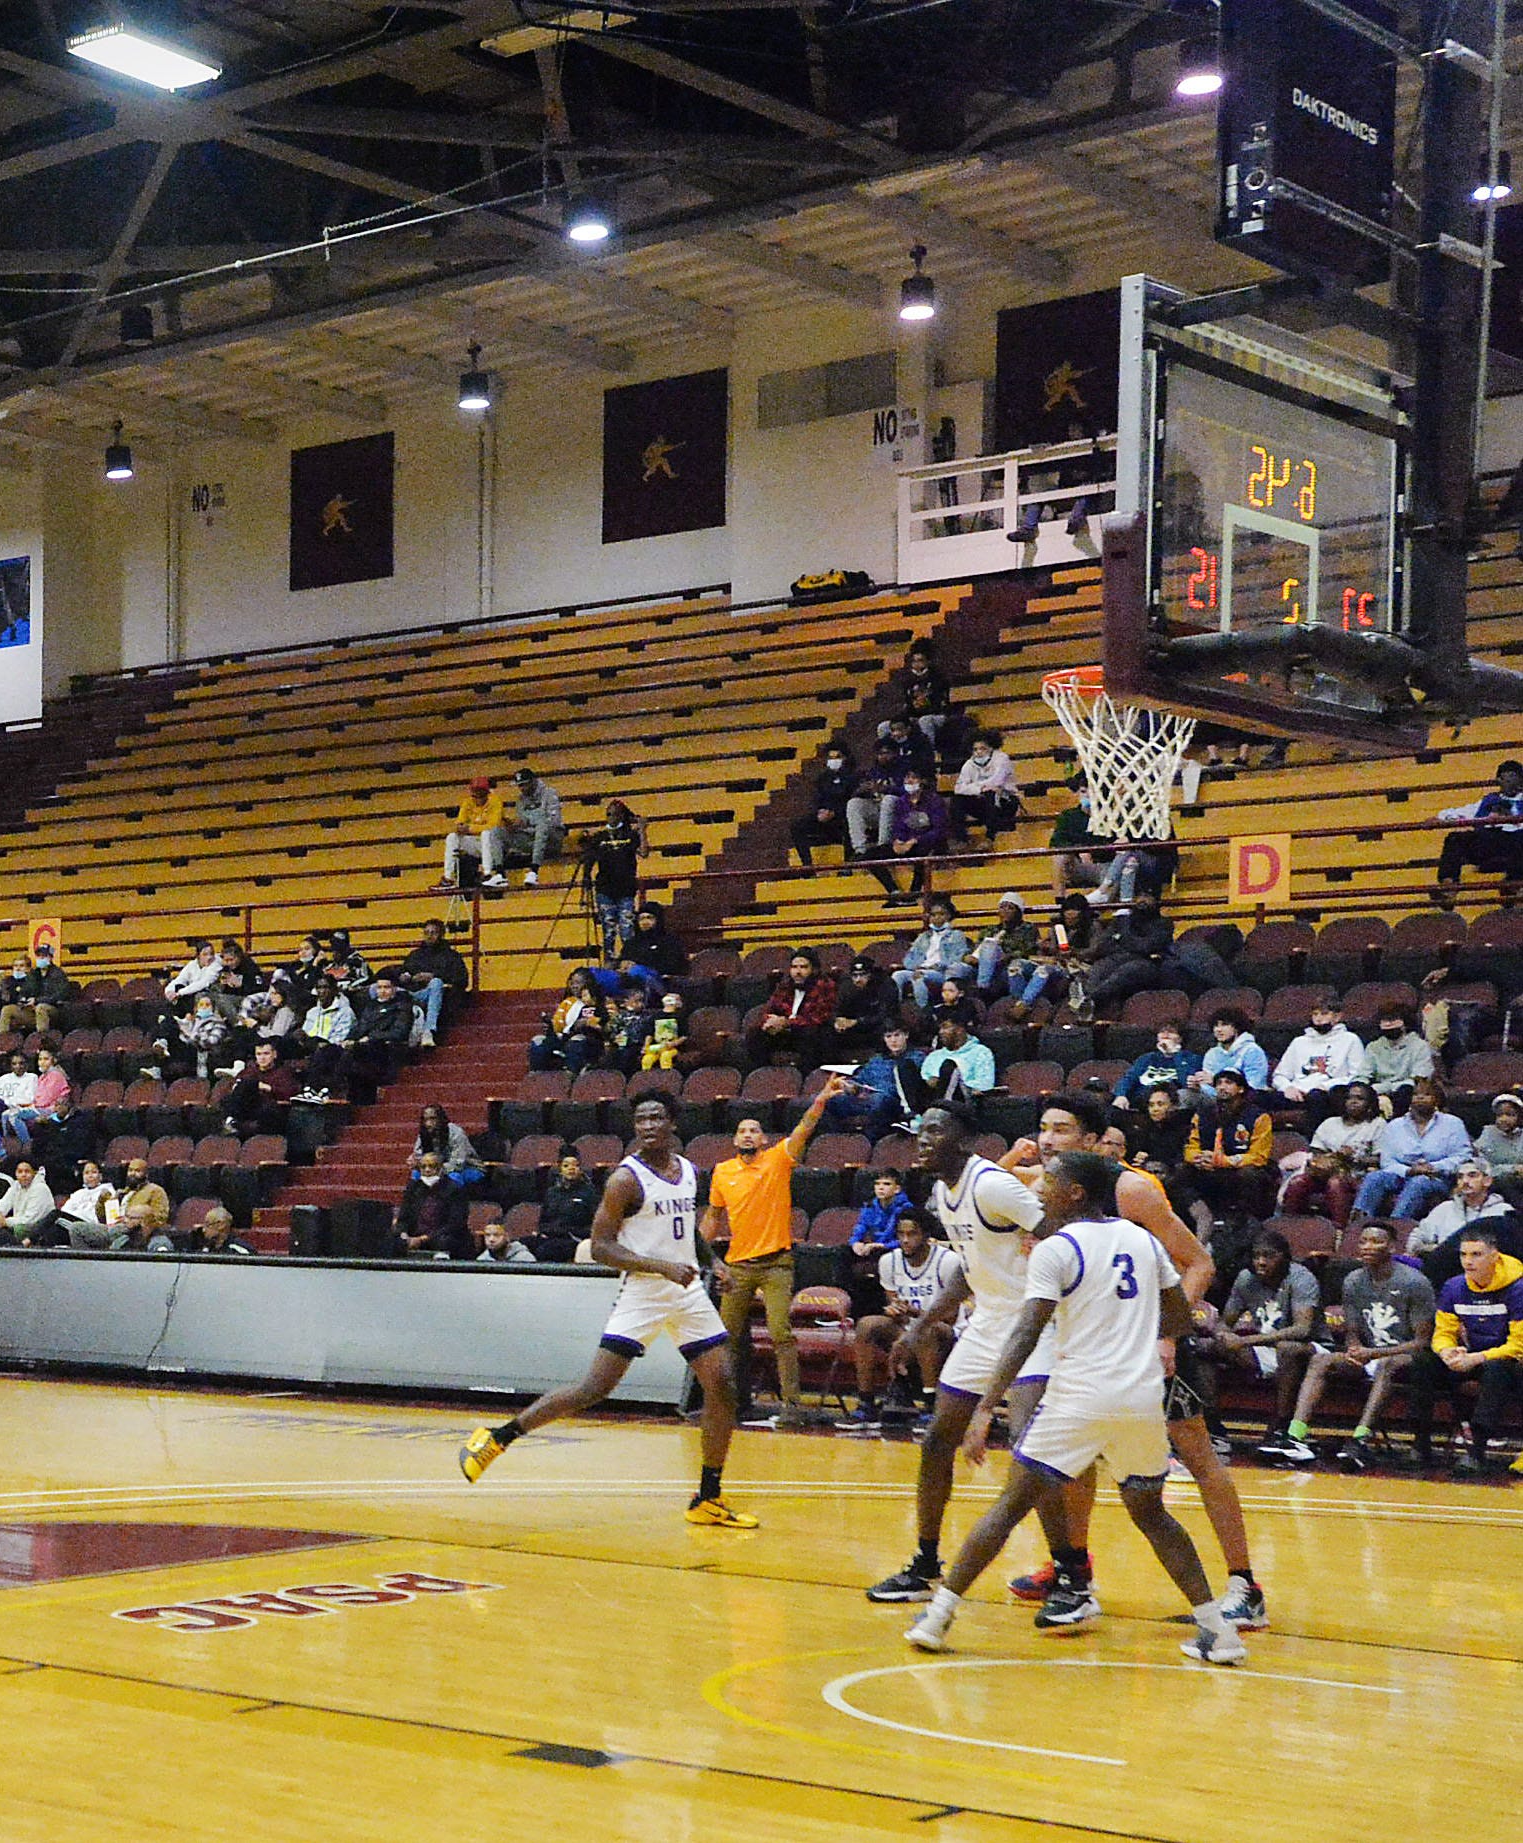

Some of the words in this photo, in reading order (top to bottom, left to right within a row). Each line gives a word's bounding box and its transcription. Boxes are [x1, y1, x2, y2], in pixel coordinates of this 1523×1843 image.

[1292, 87, 1378, 146] DAKTRONICS
[874, 409, 898, 446] NO
[192, 484, 209, 512] NO
[1238, 844, 1281, 895] D
[673, 1217, 684, 1240] 0
[1112, 1254, 1138, 1300] 3
[110, 1571, 506, 1634] PSAC
